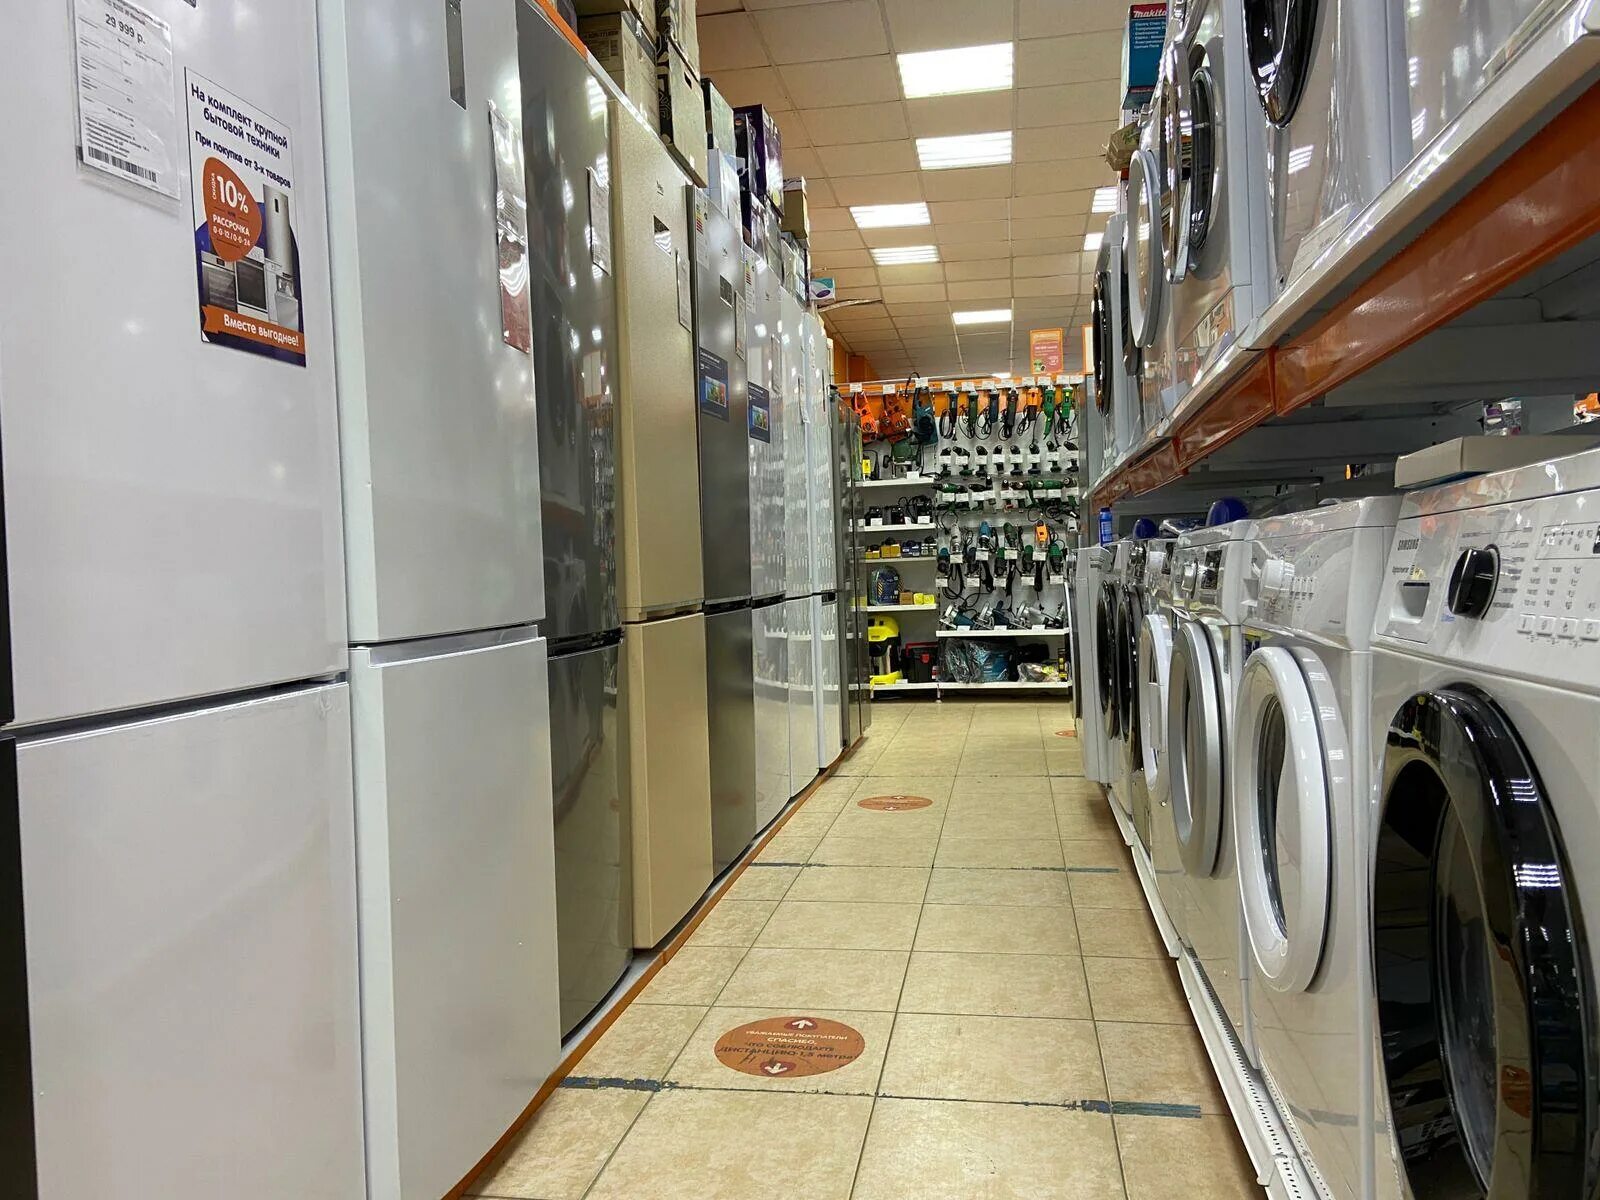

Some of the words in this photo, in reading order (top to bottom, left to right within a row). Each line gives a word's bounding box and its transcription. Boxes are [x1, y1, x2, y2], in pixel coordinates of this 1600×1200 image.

[105, 13, 116, 28] 29
[119, 21, 135, 38] 999
[191, 83, 205, 102] На
[207, 95, 252, 128] комплект
[254, 122, 288, 149] крупной
[203, 107, 245, 139] бытовой
[246, 132, 280, 159] техники
[195, 131, 212, 148] При
[213, 141, 243, 164] покупке
[244, 157, 253, 168] от
[266, 169, 291, 189] товаров
[216, 175, 249, 213] 10%
[212, 214, 250, 237] РАССРОЧКА
[223, 313, 256, 334] Вместе
[258, 326, 299, 347] выгоднее!
[1397, 538, 1420, 551] SAMSUNG
